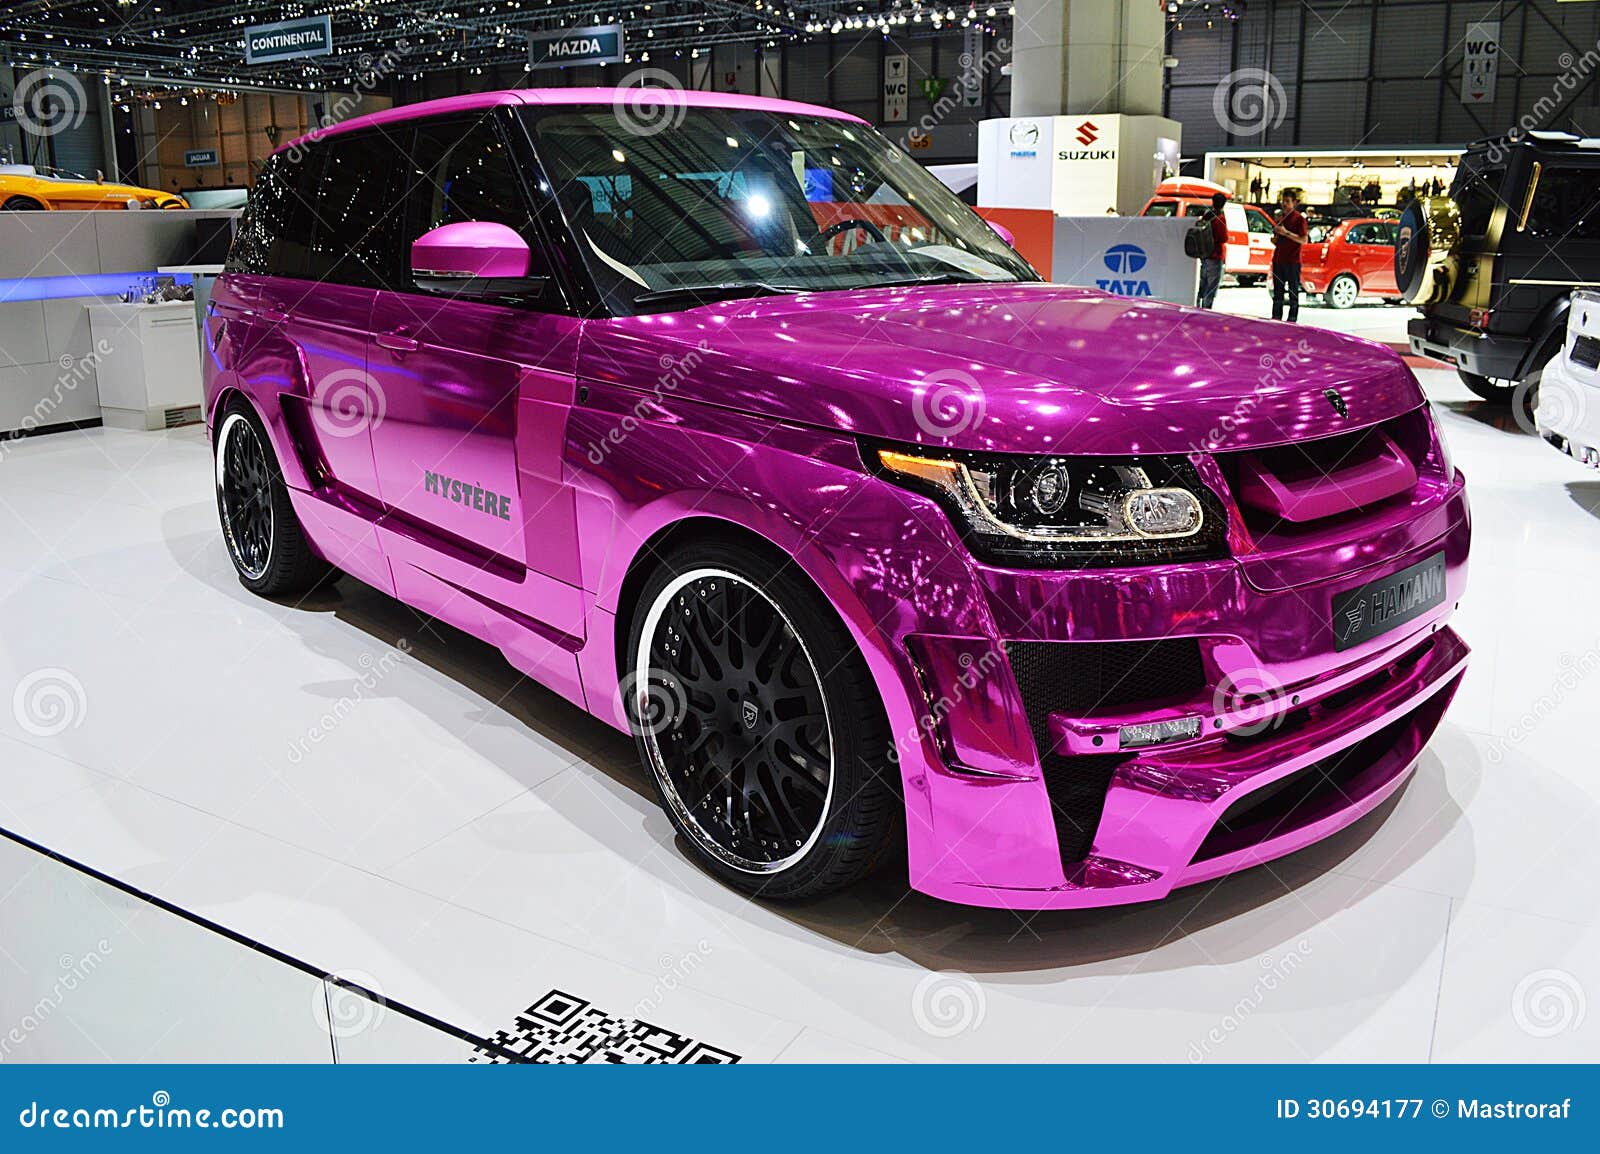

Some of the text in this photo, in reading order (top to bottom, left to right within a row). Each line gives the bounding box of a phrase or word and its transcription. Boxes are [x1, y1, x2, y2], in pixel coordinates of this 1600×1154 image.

[252, 29, 324, 51] CONTINENTAL
[549, 38, 601, 57] MAZDA
[1467, 41, 1497, 55] WC
[885, 84, 907, 96] WC
[1058, 150, 1115, 160] SUZUKI
[1096, 280, 1152, 297] TATA
[425, 470, 511, 521] MYSTÈRE
[1371, 565, 1441, 627] HAMANN
